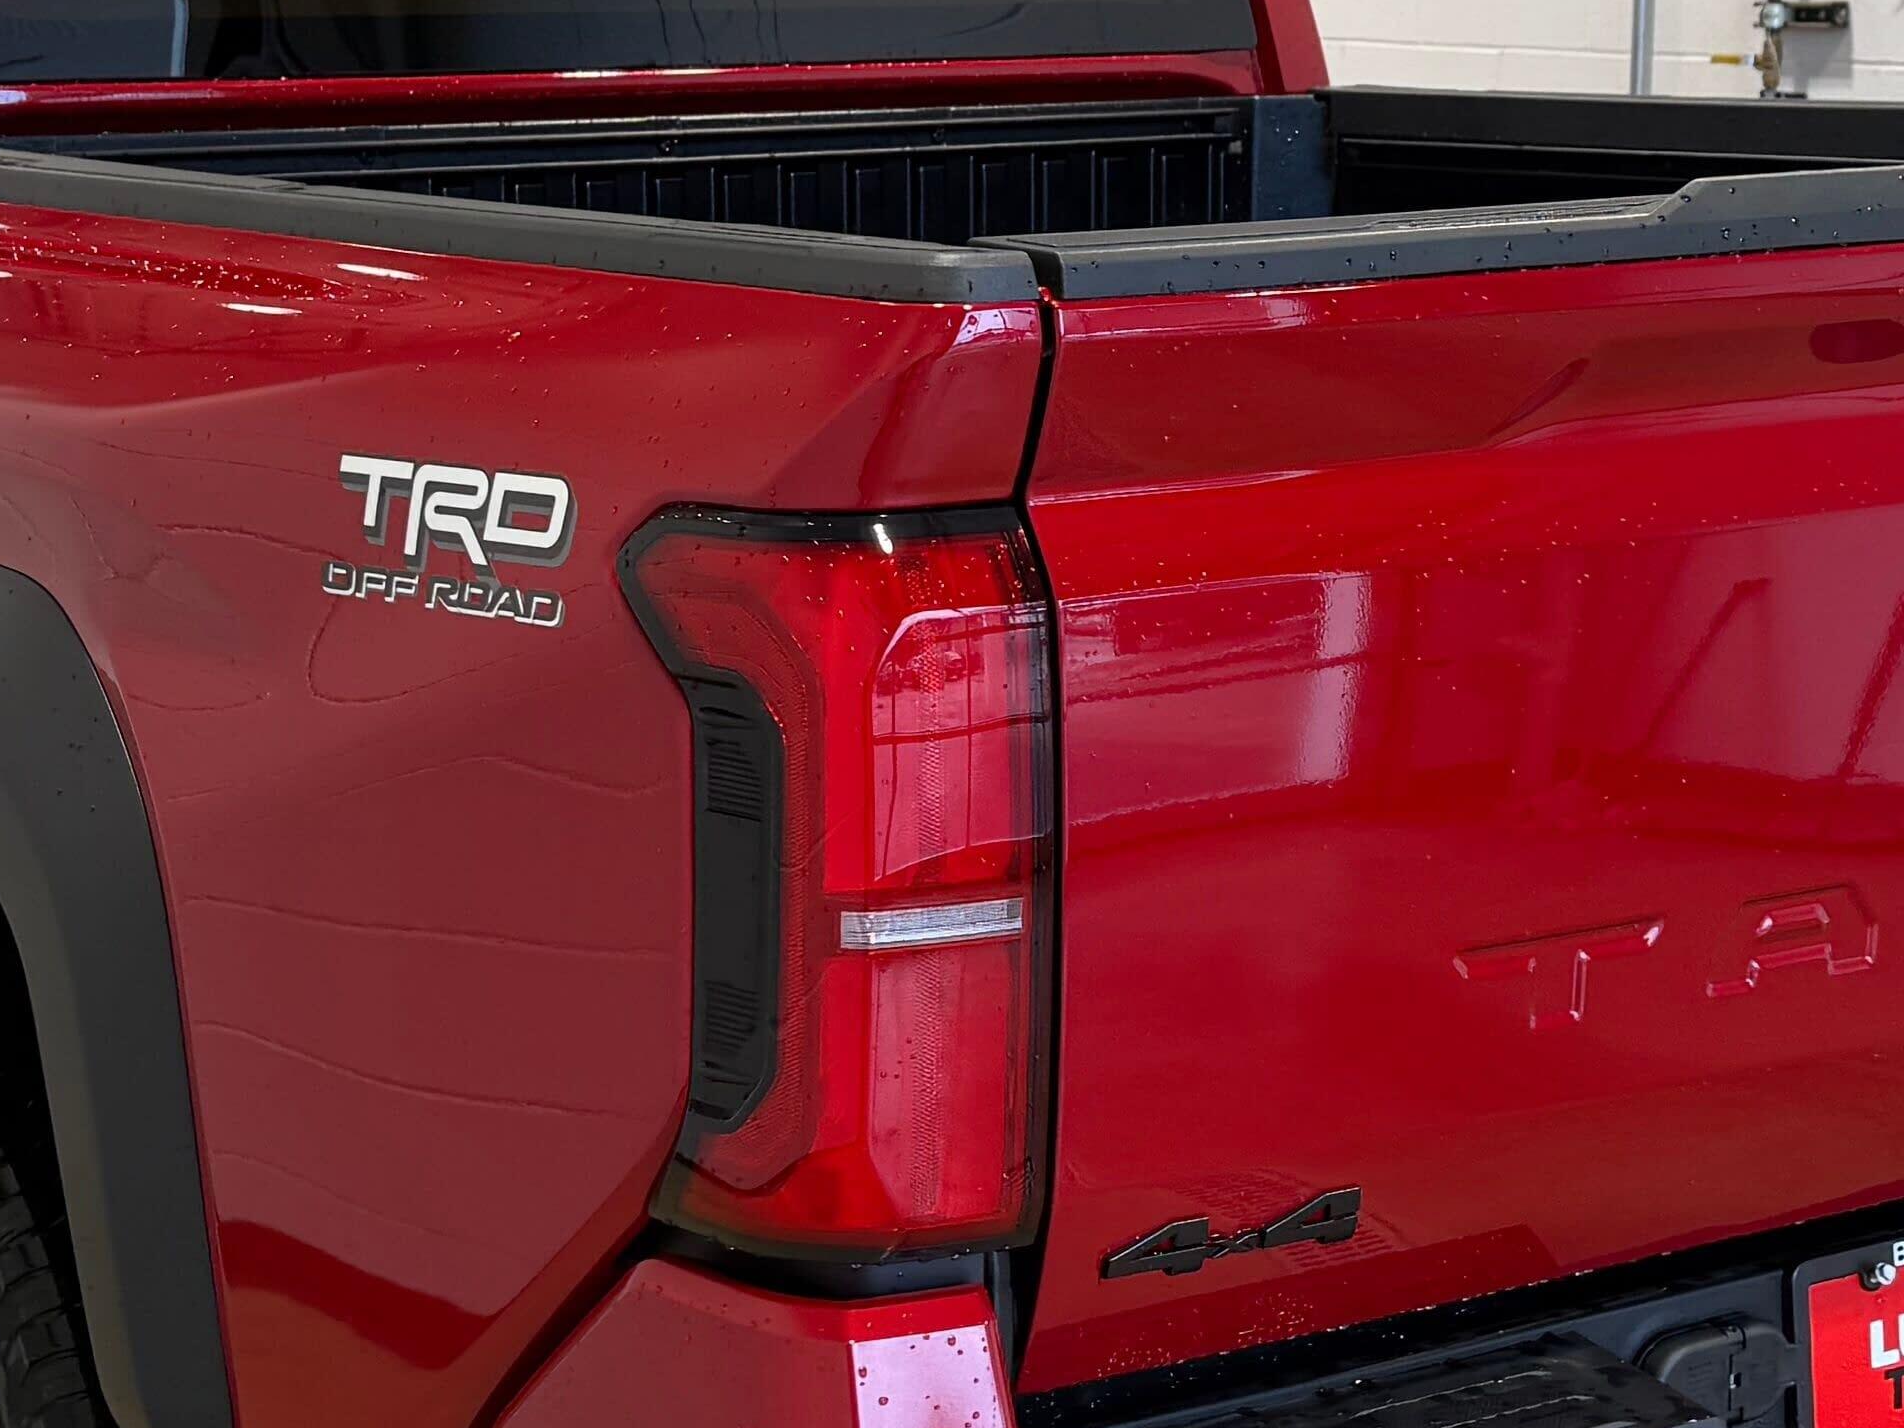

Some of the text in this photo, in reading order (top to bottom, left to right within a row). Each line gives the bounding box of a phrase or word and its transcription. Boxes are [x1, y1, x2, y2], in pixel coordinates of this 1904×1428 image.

[339, 452, 576, 572] TRD
[321, 560, 566, 628] OFF ROAD
